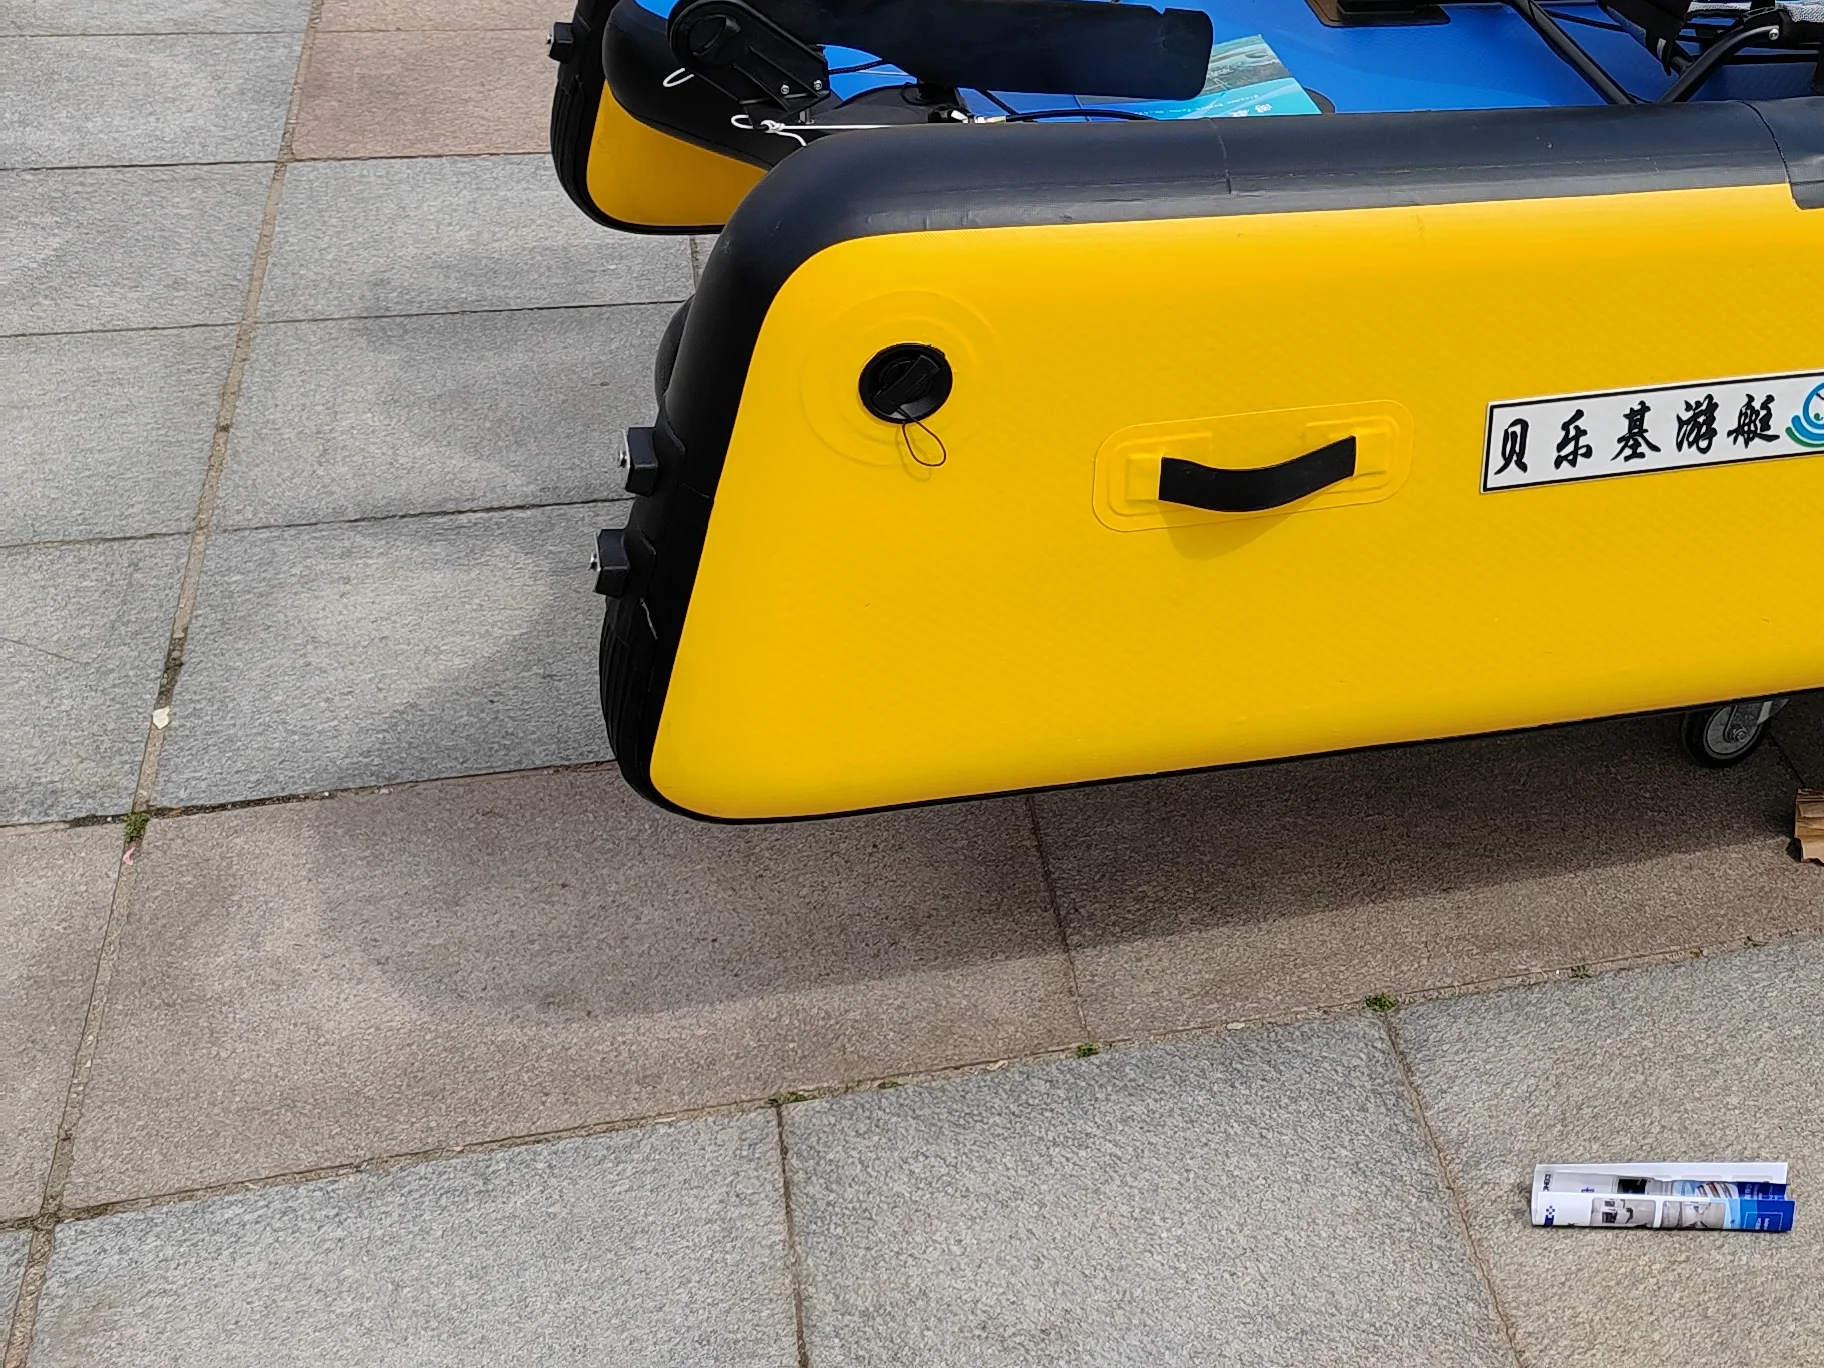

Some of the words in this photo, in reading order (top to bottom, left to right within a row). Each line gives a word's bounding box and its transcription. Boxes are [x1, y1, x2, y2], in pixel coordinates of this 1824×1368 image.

[1494, 392, 1782, 477] 贝乐基游艇
